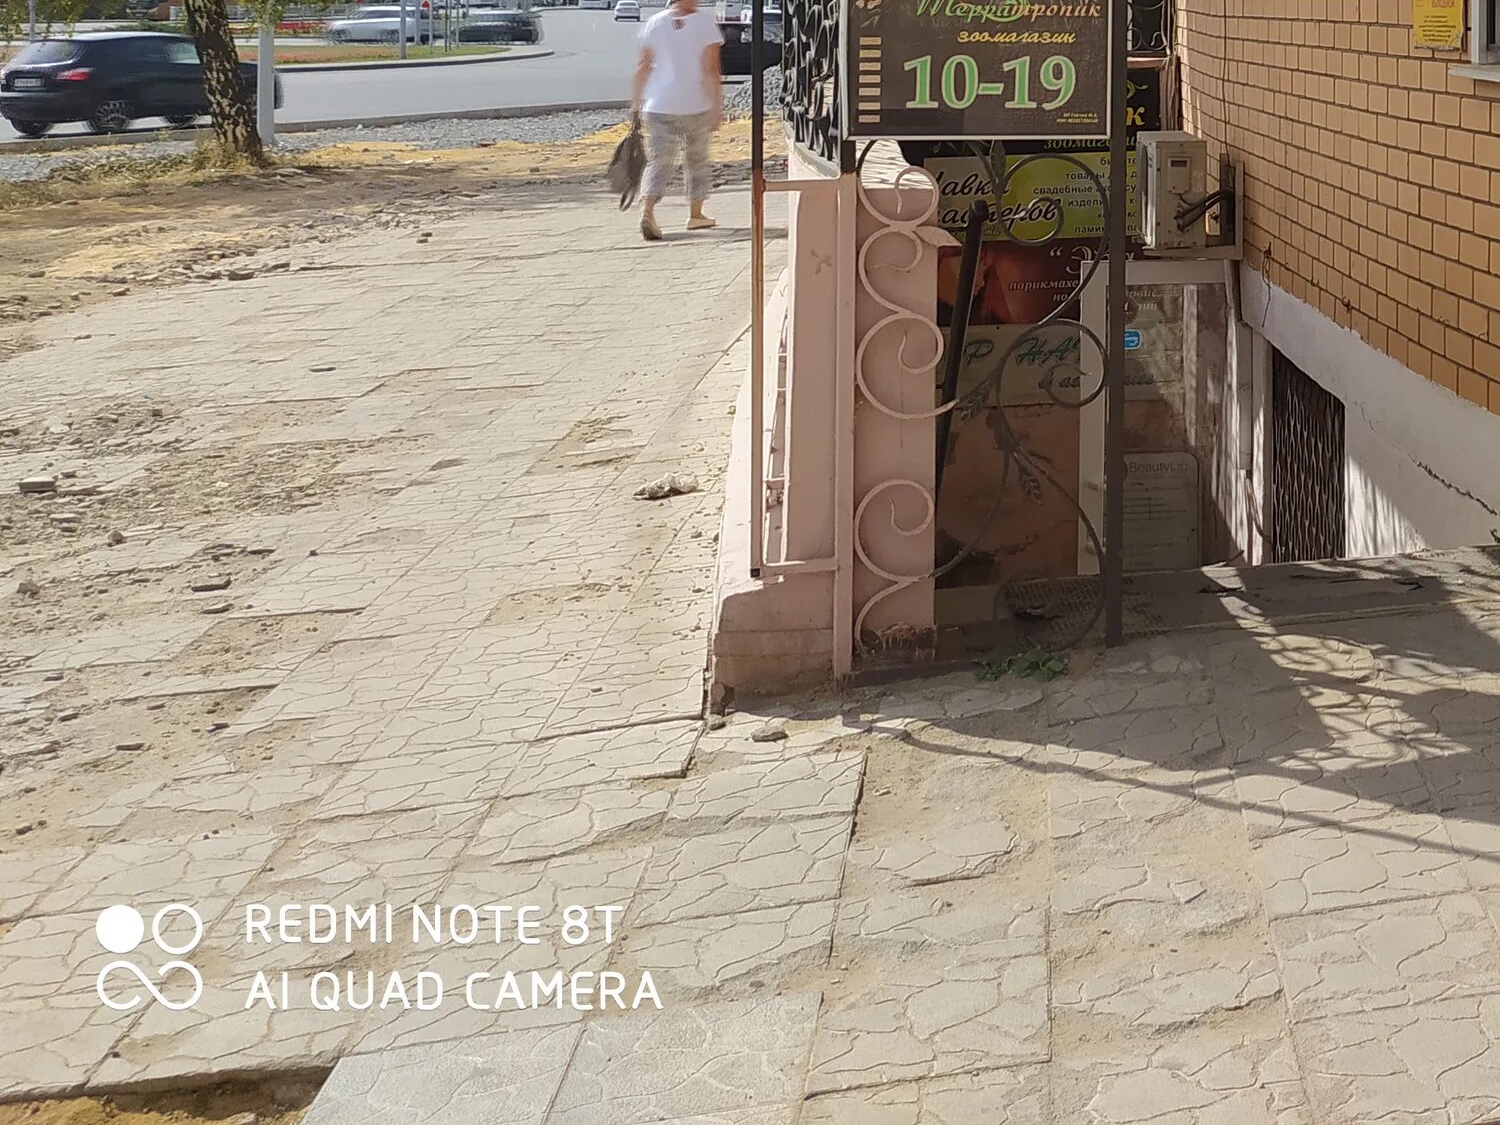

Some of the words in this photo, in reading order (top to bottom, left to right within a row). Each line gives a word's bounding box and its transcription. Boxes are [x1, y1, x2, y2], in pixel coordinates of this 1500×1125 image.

[956, 30, 1076, 44] зоомагазин
[903, 54, 1076, 110] 10-19
[1033, 185, 1093, 195] свадебные
